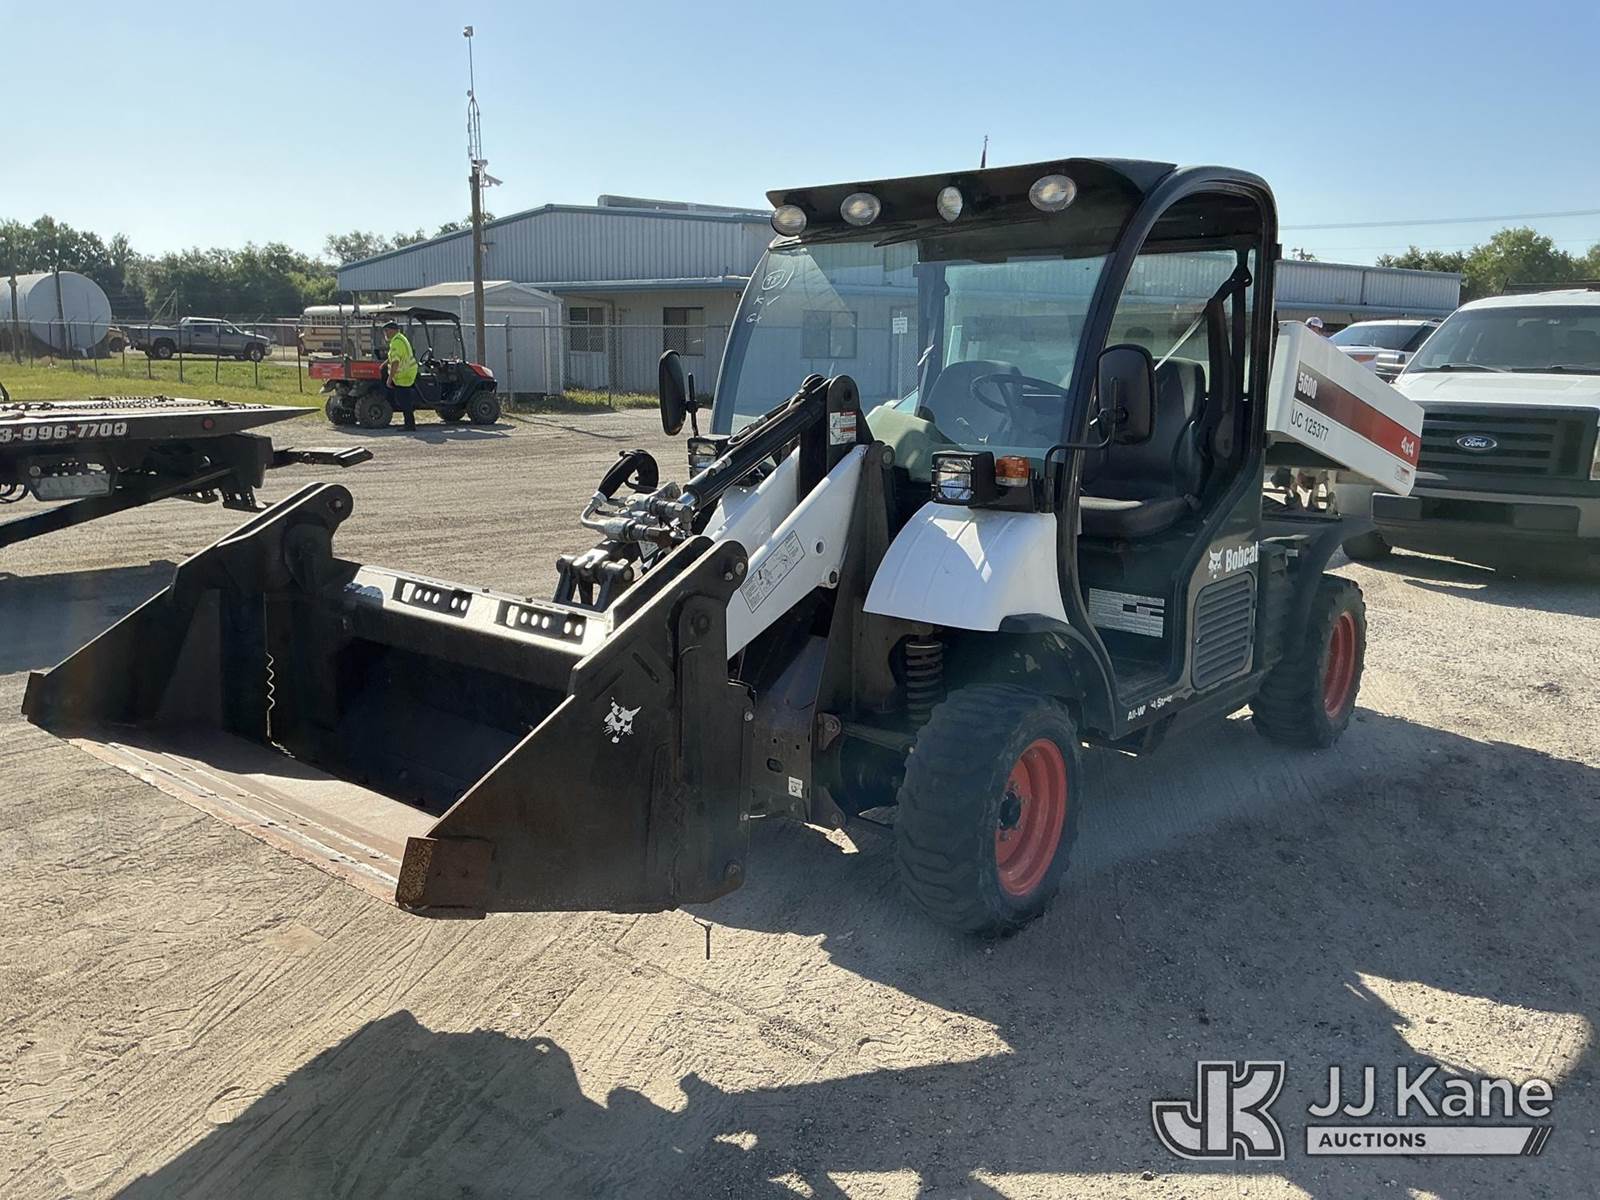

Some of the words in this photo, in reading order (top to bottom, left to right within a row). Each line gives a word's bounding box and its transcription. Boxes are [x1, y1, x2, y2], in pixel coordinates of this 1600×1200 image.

[1298, 371, 1318, 399] 5600
[1291, 409, 1303, 428] UC
[1305, 416, 1329, 441] 125377
[1401, 436, 1415, 457] 4x4
[1464, 437, 1487, 448] Ford
[1225, 541, 1259, 572] Bobcat
